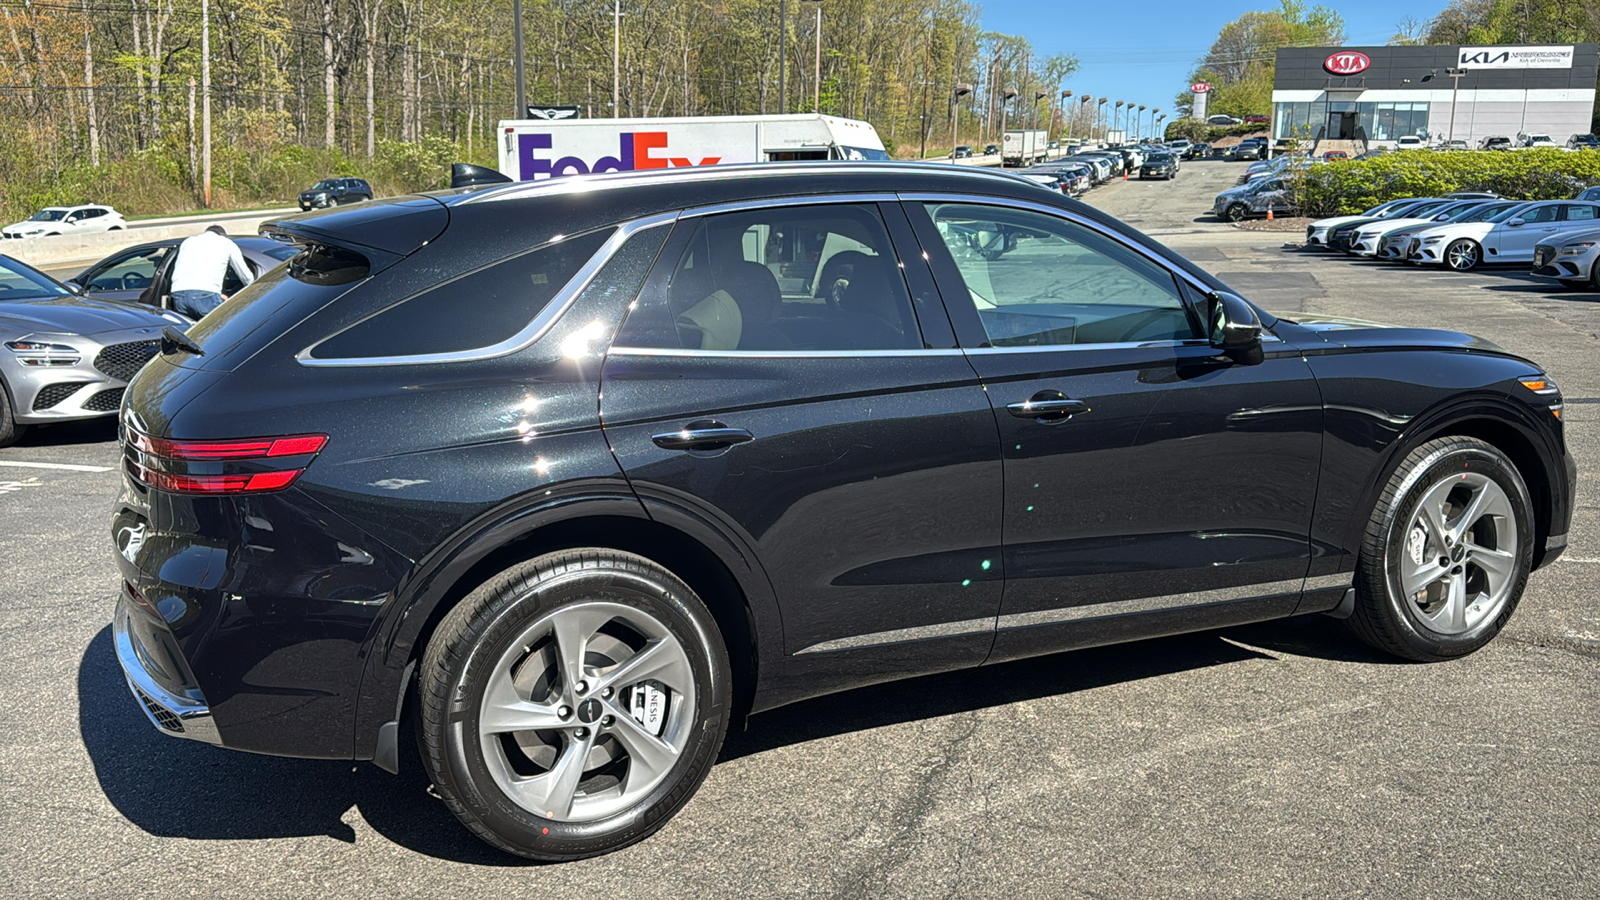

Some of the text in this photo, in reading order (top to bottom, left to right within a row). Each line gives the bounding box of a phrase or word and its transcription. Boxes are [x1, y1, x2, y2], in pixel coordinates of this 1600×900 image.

[1331, 55, 1362, 70] KIA
[1461, 51, 1509, 64] KIA
[649, 680, 660, 723] GENESIS
